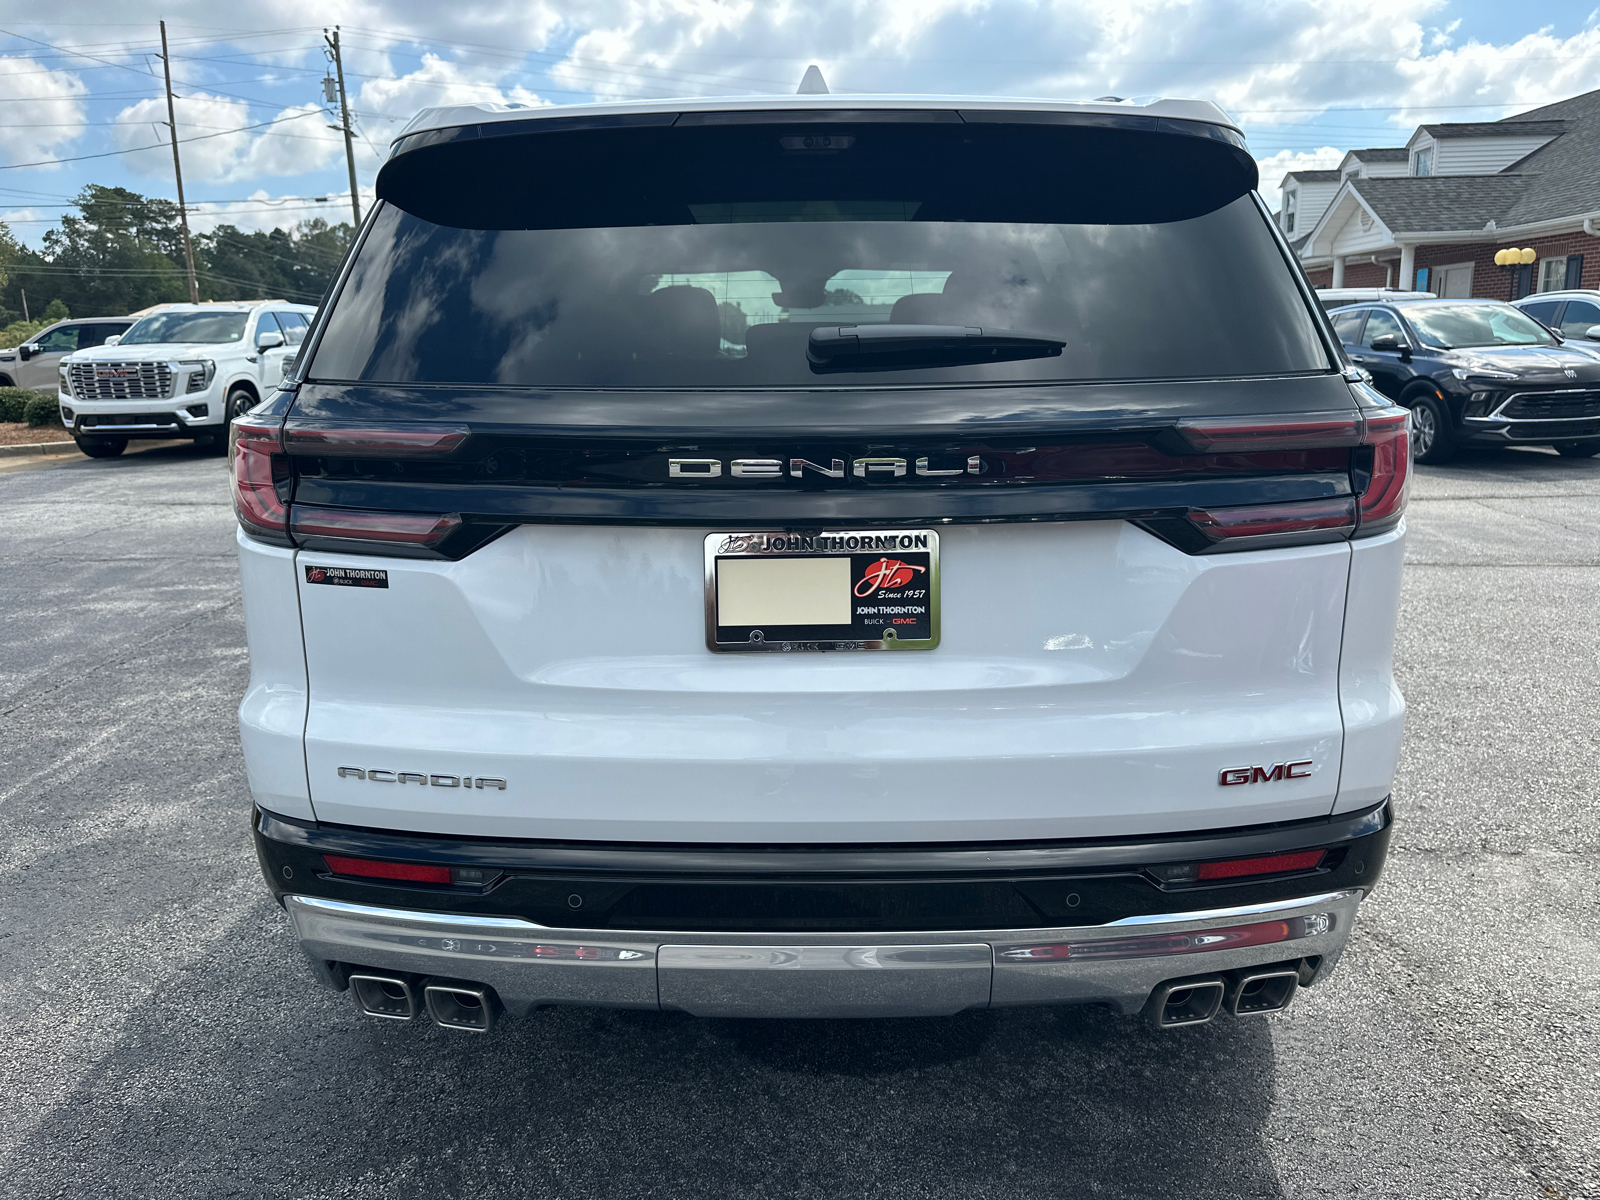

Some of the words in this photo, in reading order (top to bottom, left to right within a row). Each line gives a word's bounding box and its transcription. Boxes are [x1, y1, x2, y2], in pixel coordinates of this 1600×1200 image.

[97, 369, 137, 377] GMC
[669, 455, 980, 478] DENALI
[761, 536, 814, 552] JOHN
[820, 534, 928, 551] THORNTON
[326, 568, 345, 577] JOHN
[346, 569, 386, 579] THORNTON
[361, 579, 379, 587] GMC
[877, 590, 902, 599] Since
[903, 589, 926, 599] 1957
[856, 606, 878, 614] JOHN
[878, 606, 925, 614] THORNTON
[337, 764, 507, 791] ACADIA
[1218, 758, 1313, 787] GMC
